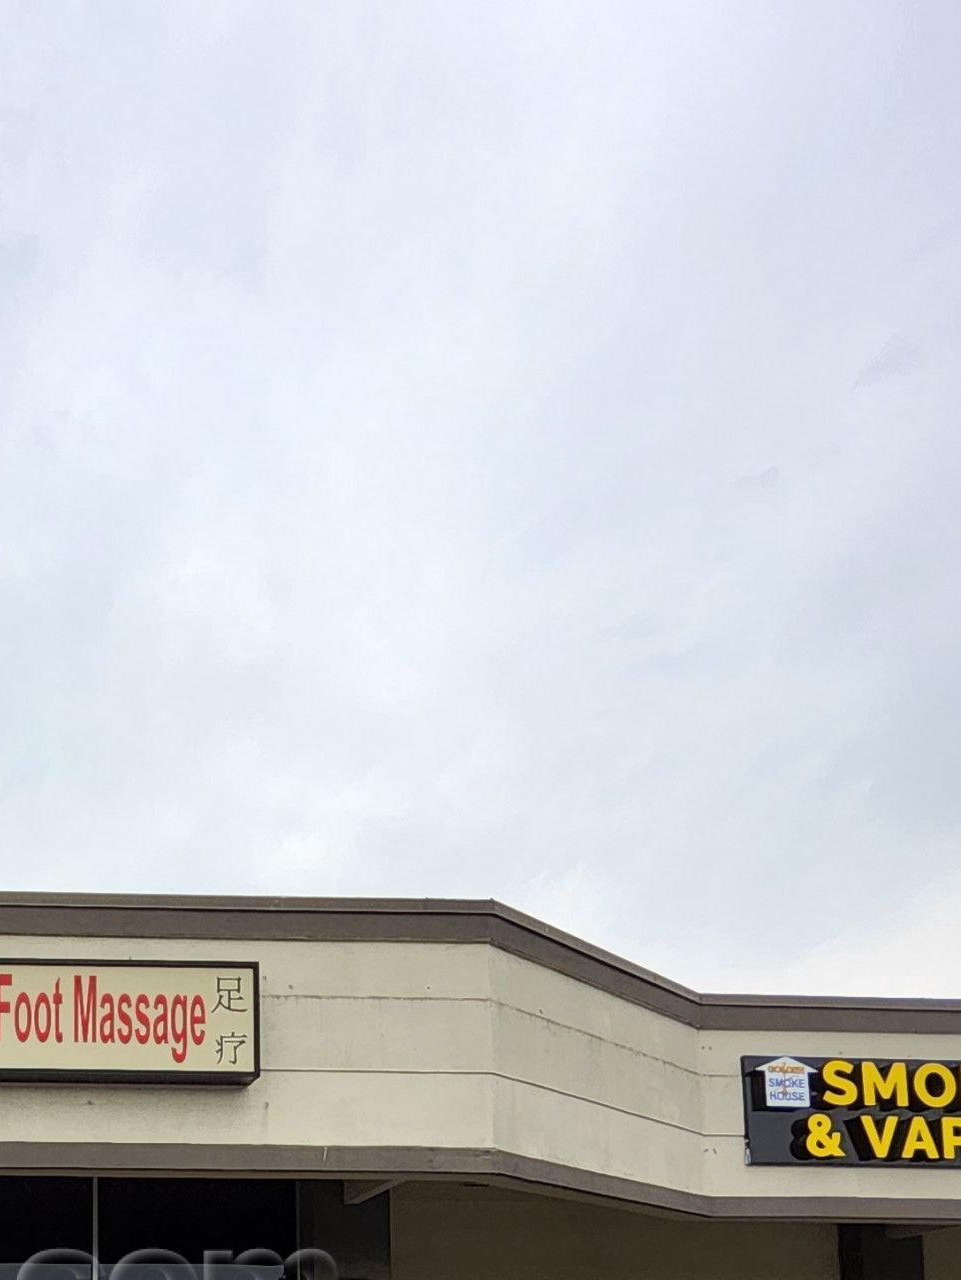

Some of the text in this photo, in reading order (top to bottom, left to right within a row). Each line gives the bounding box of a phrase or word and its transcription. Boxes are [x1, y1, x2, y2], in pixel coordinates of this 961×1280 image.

[73, 974, 206, 1064] Massage
[769, 1078, 805, 1088] SMOKE
[770, 1091, 805, 1101] HOUSE
[806, 1113, 846, 1158] &
